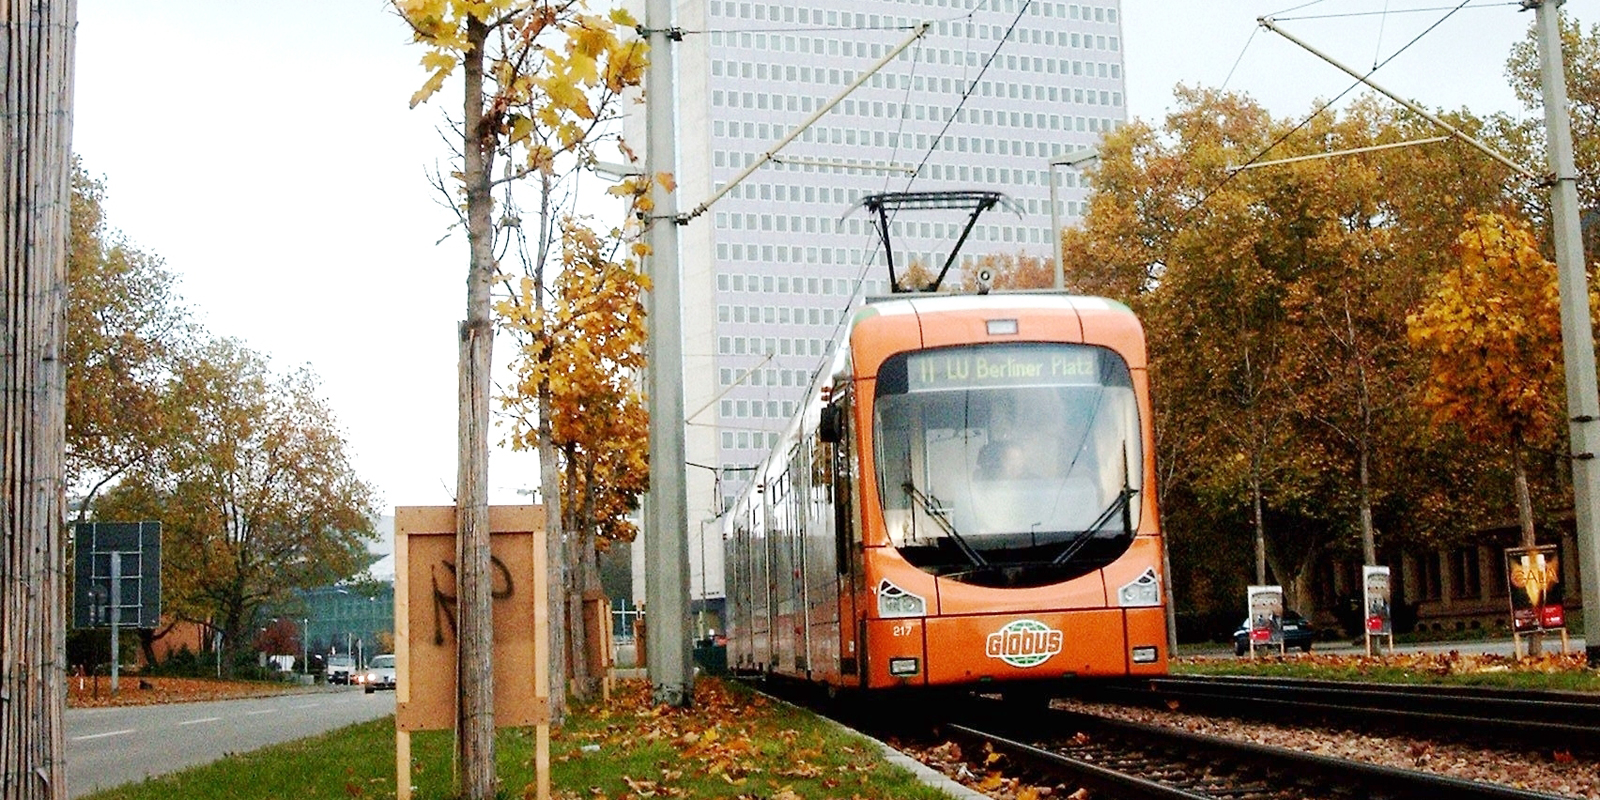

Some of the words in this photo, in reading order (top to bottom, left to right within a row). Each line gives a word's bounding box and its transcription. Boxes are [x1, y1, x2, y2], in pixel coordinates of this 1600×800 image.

[946, 359, 969, 381] LU
[976, 357, 1041, 379] Berliner
[1052, 355, 1094, 376] Platz
[893, 625, 912, 637] 217
